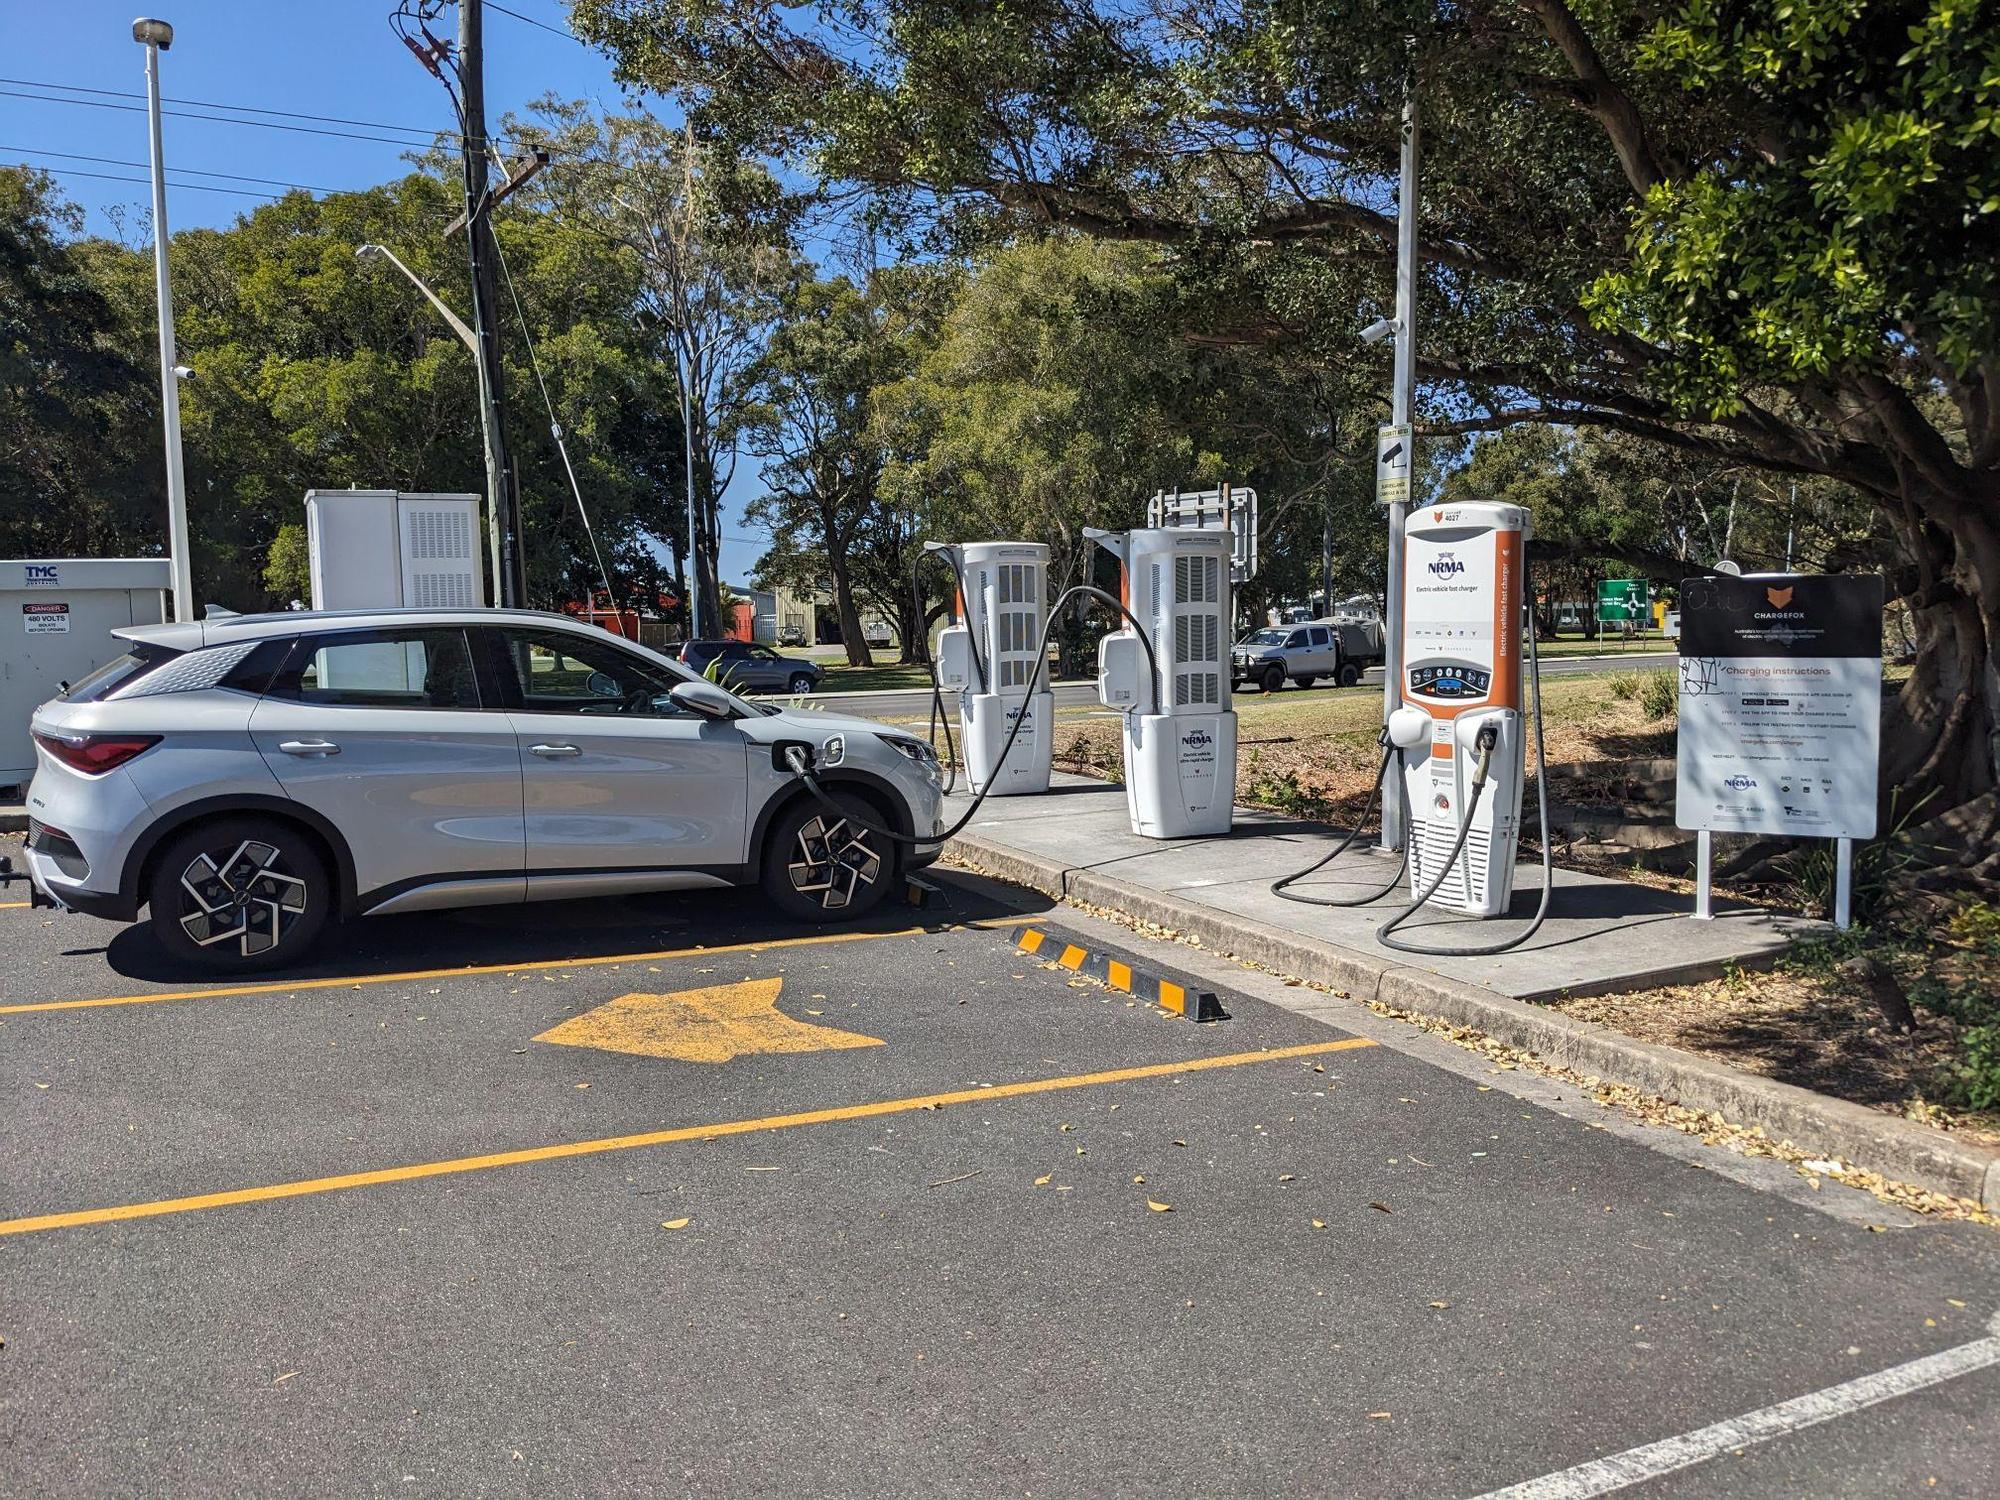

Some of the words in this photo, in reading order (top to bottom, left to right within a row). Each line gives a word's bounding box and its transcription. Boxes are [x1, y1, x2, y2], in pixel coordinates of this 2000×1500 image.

[25, 566, 58, 577] TMC
[1428, 561, 1465, 574] NRMA
[1502, 563, 1510, 590] charger
[1458, 585, 1478, 593] charger
[1726, 667, 1771, 677] Charging
[1773, 667, 1831, 676] instructions
[1181, 735, 1212, 744] NRMA
[1724, 779, 1758, 787] NRMA
